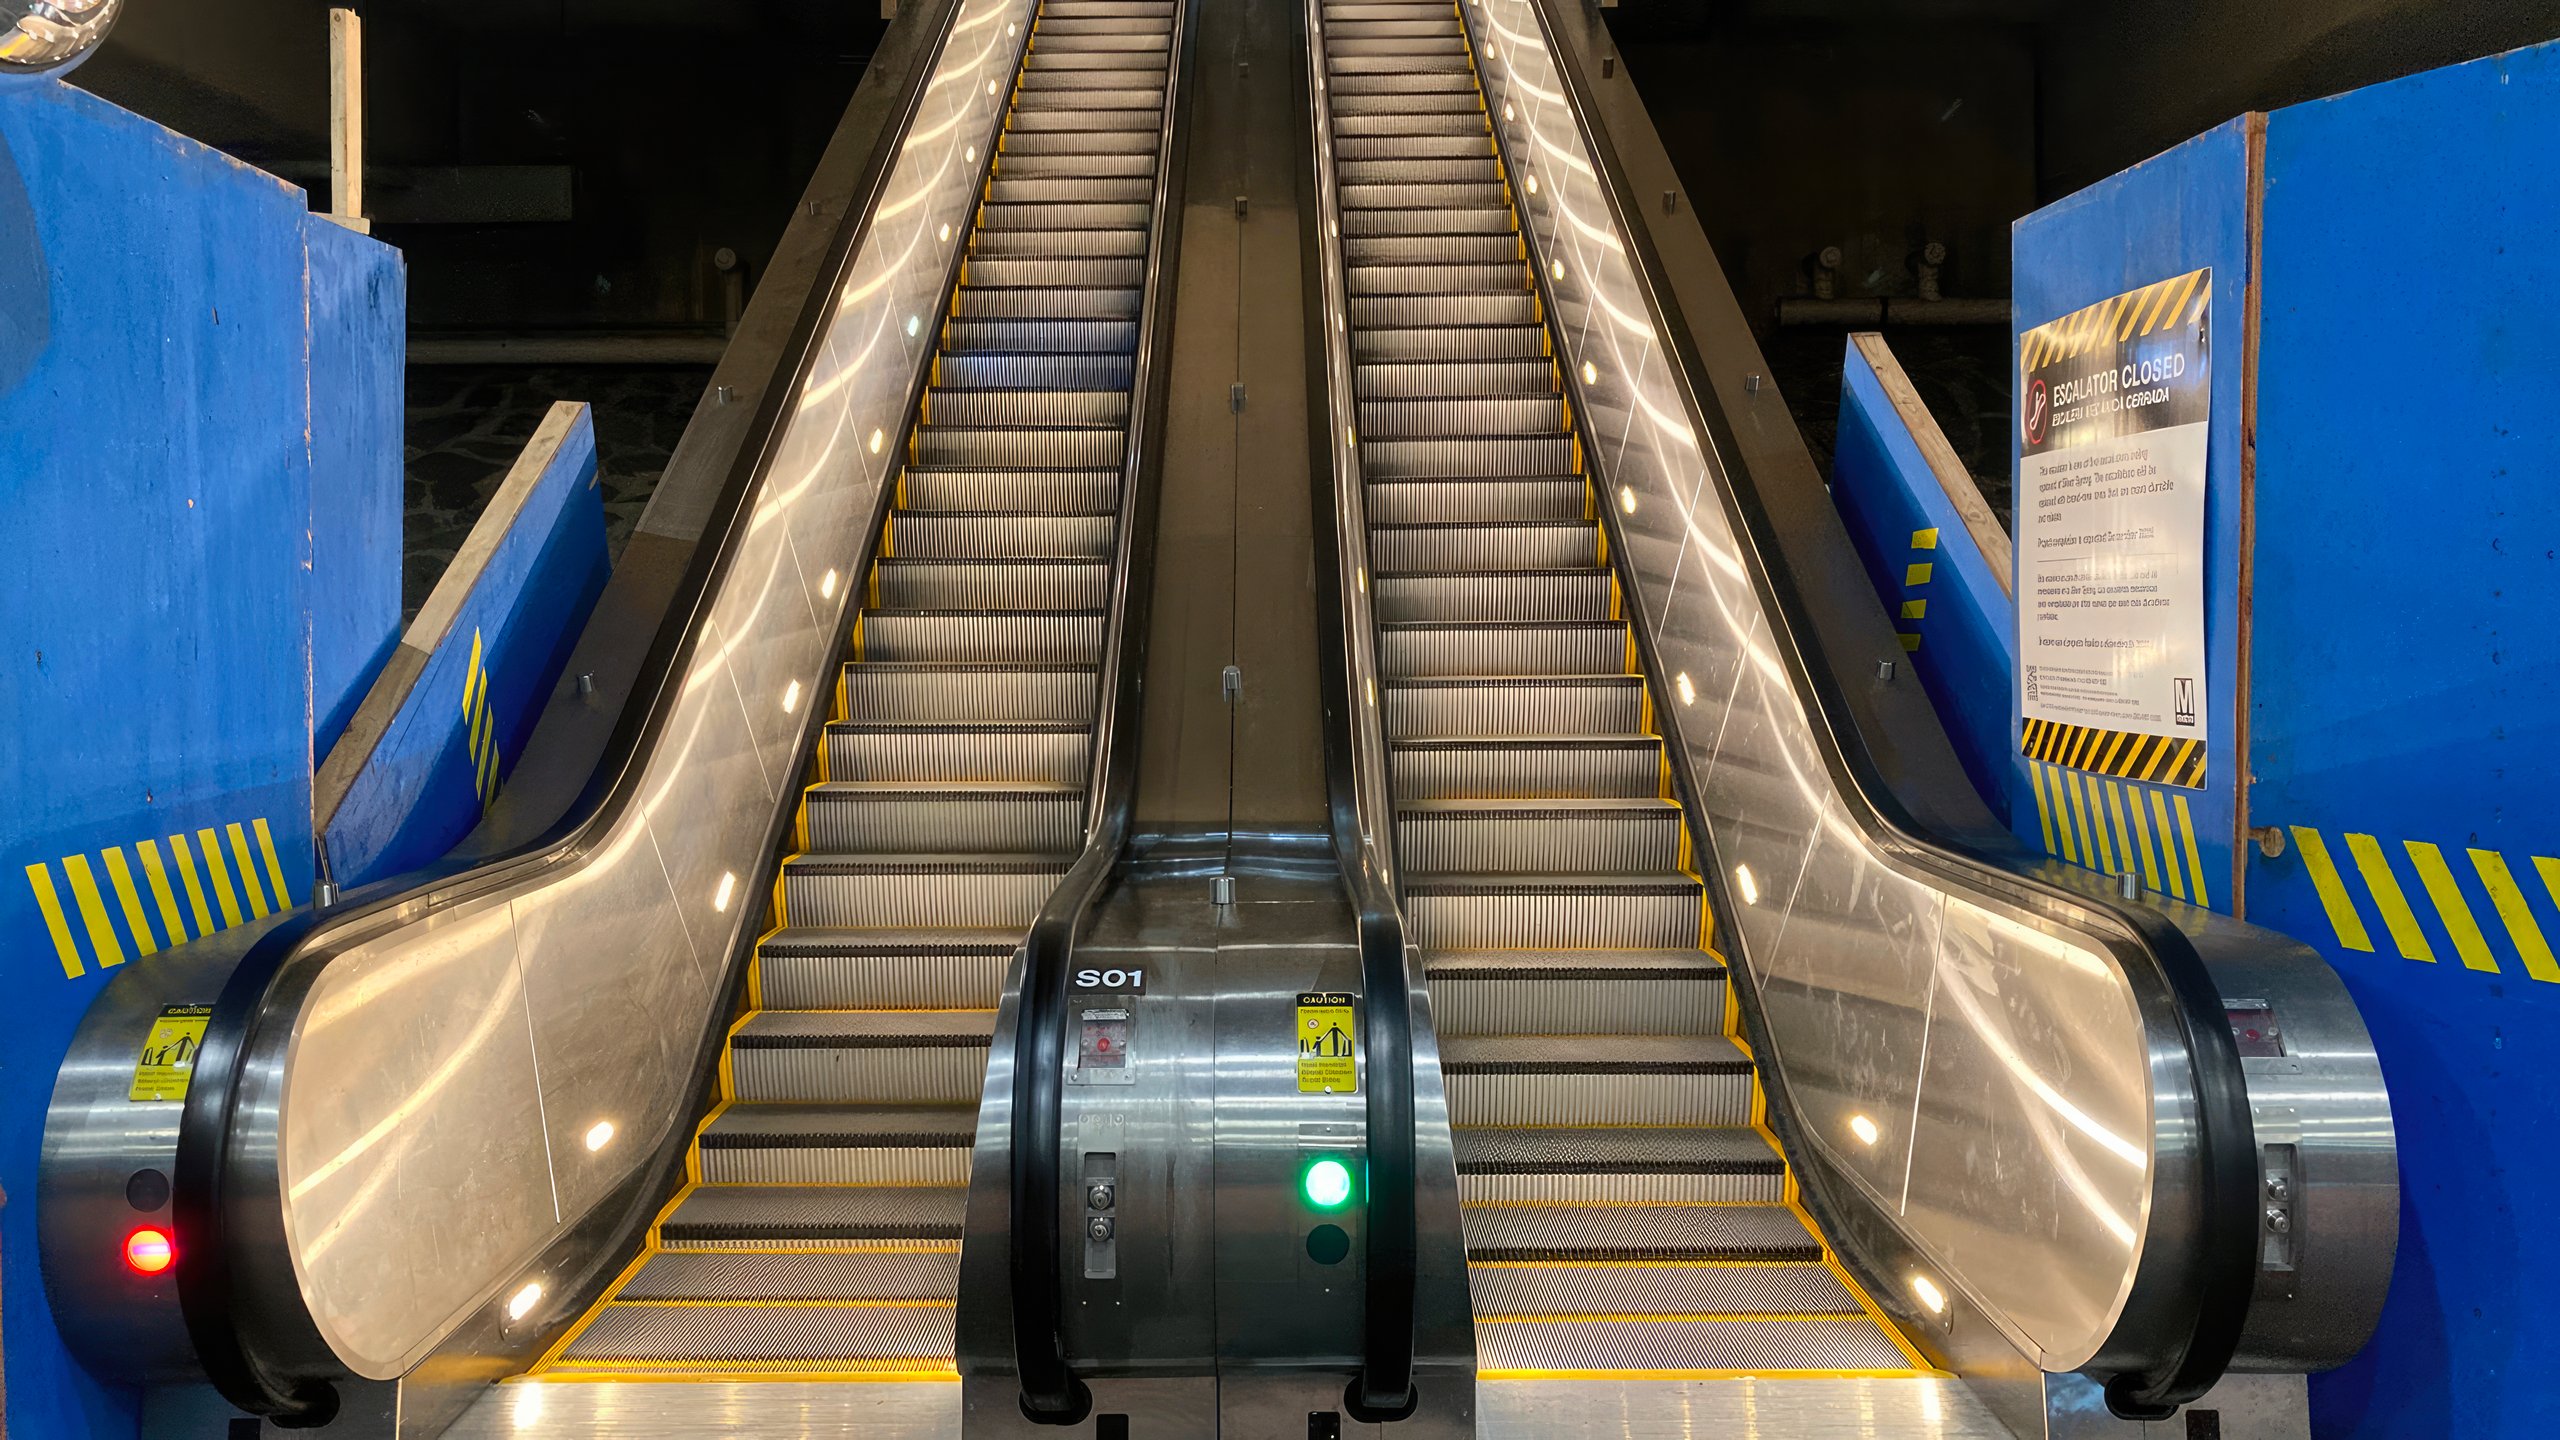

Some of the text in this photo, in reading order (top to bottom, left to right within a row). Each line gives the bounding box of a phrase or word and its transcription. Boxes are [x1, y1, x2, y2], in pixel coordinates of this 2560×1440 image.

[2053, 352, 2185, 408] ESCALATOR CLOSED
[1303, 996, 1346, 1004] CAUTION
